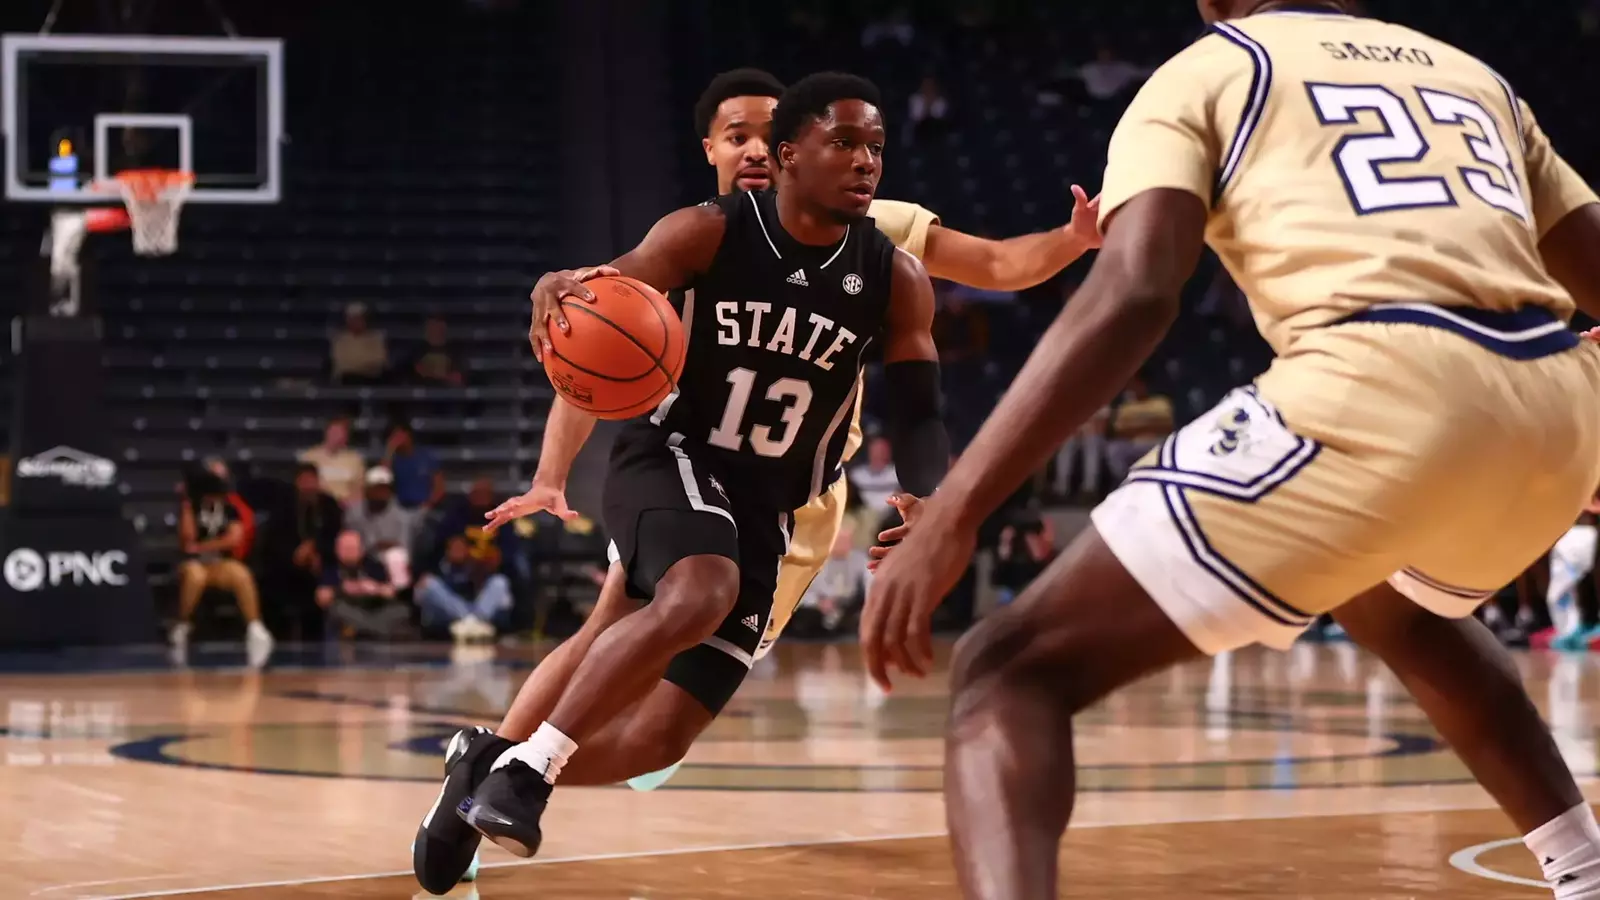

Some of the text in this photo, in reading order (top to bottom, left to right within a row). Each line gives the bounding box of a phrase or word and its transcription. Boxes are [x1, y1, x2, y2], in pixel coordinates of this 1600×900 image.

[1320, 41, 1434, 67] SACKO
[1303, 81, 1530, 222] 23
[786, 277, 809, 287] adidas
[844, 275, 861, 293] SEC
[715, 301, 857, 371] STATE
[707, 366, 813, 458] 13
[47, 550, 129, 586] PNC
